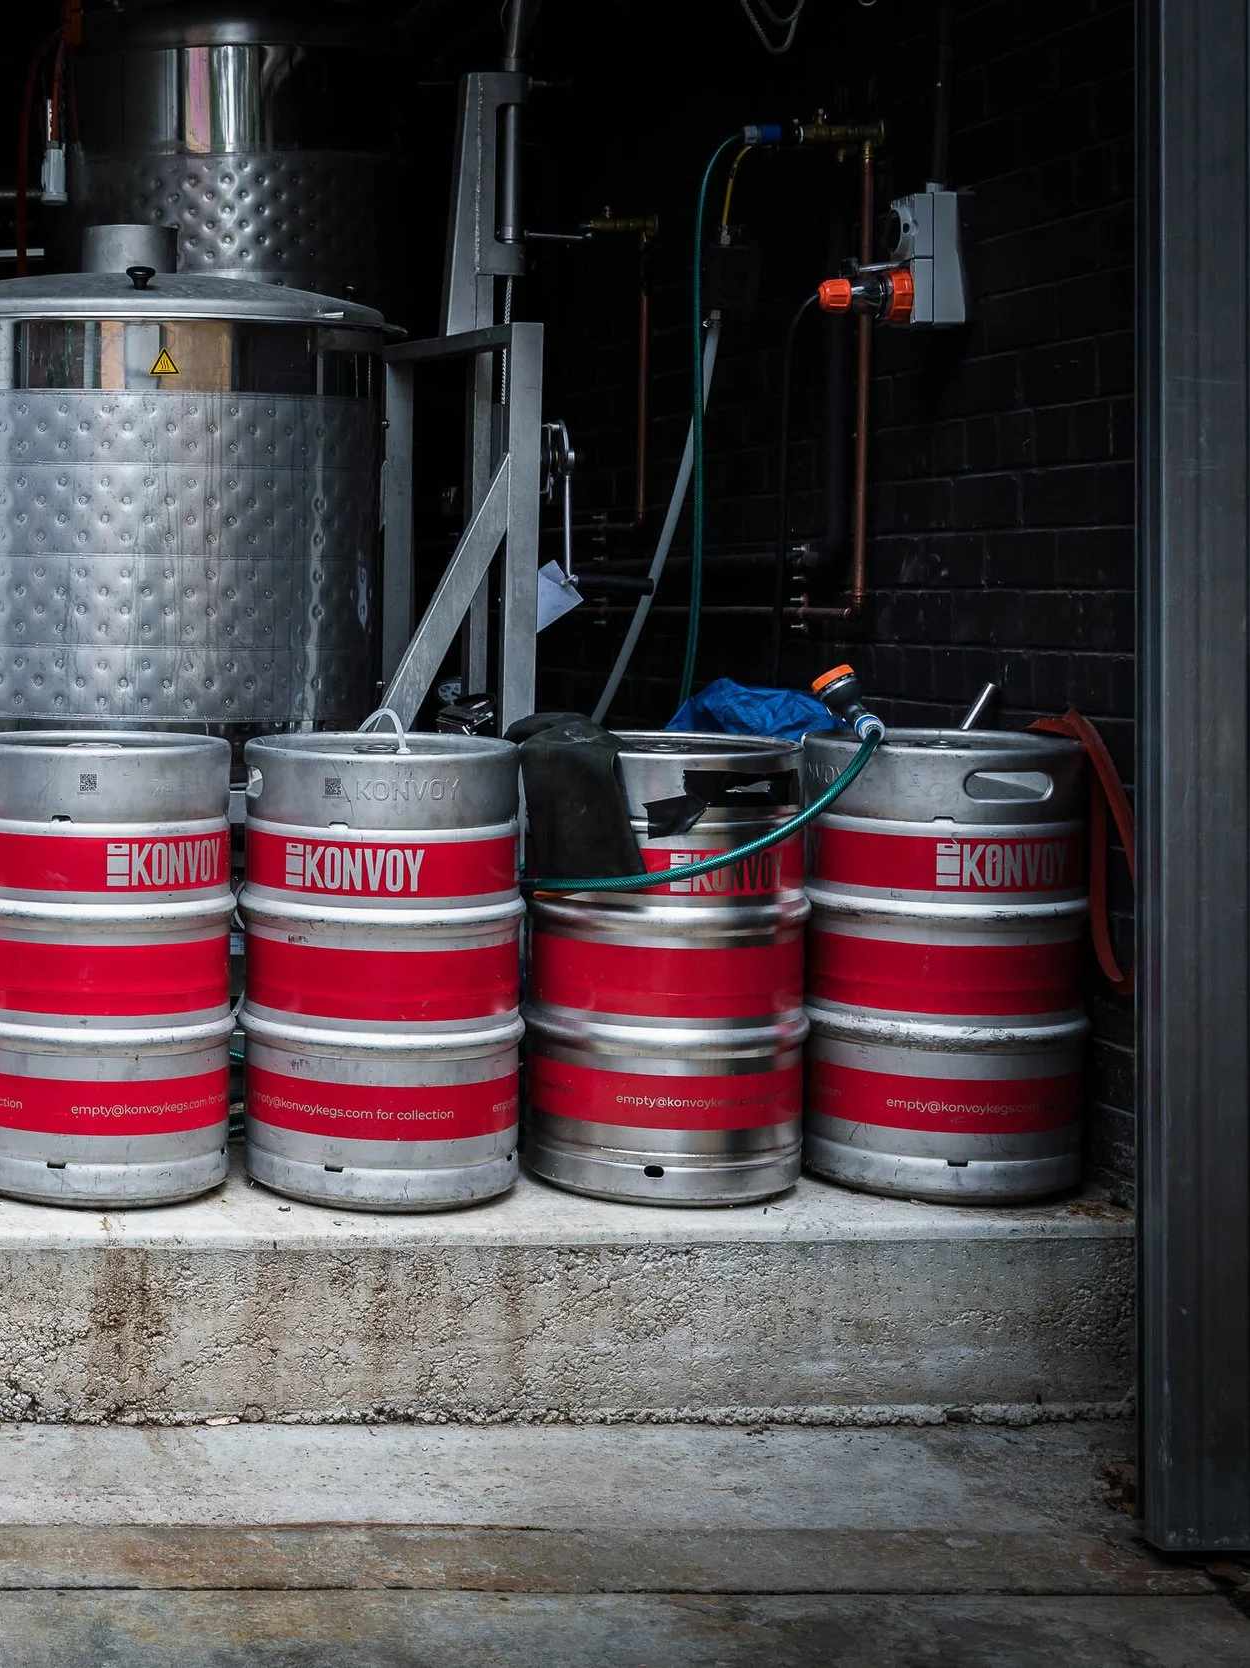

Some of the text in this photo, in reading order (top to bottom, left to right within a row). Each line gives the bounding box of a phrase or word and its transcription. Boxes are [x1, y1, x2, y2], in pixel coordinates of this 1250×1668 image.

[356, 778, 460, 802] KONVOY
[131, 837, 222, 886] KONVOY
[304, 844, 426, 892] KONVOY
[962, 842, 1067, 887] KONVOY
[70, 1098, 207, 1118] empty@konvoykegs.com
[376, 1109, 394, 1121] for
[396, 1108, 455, 1121] collection
[885, 1097, 1040, 1116] empty@konvoykegs.com
